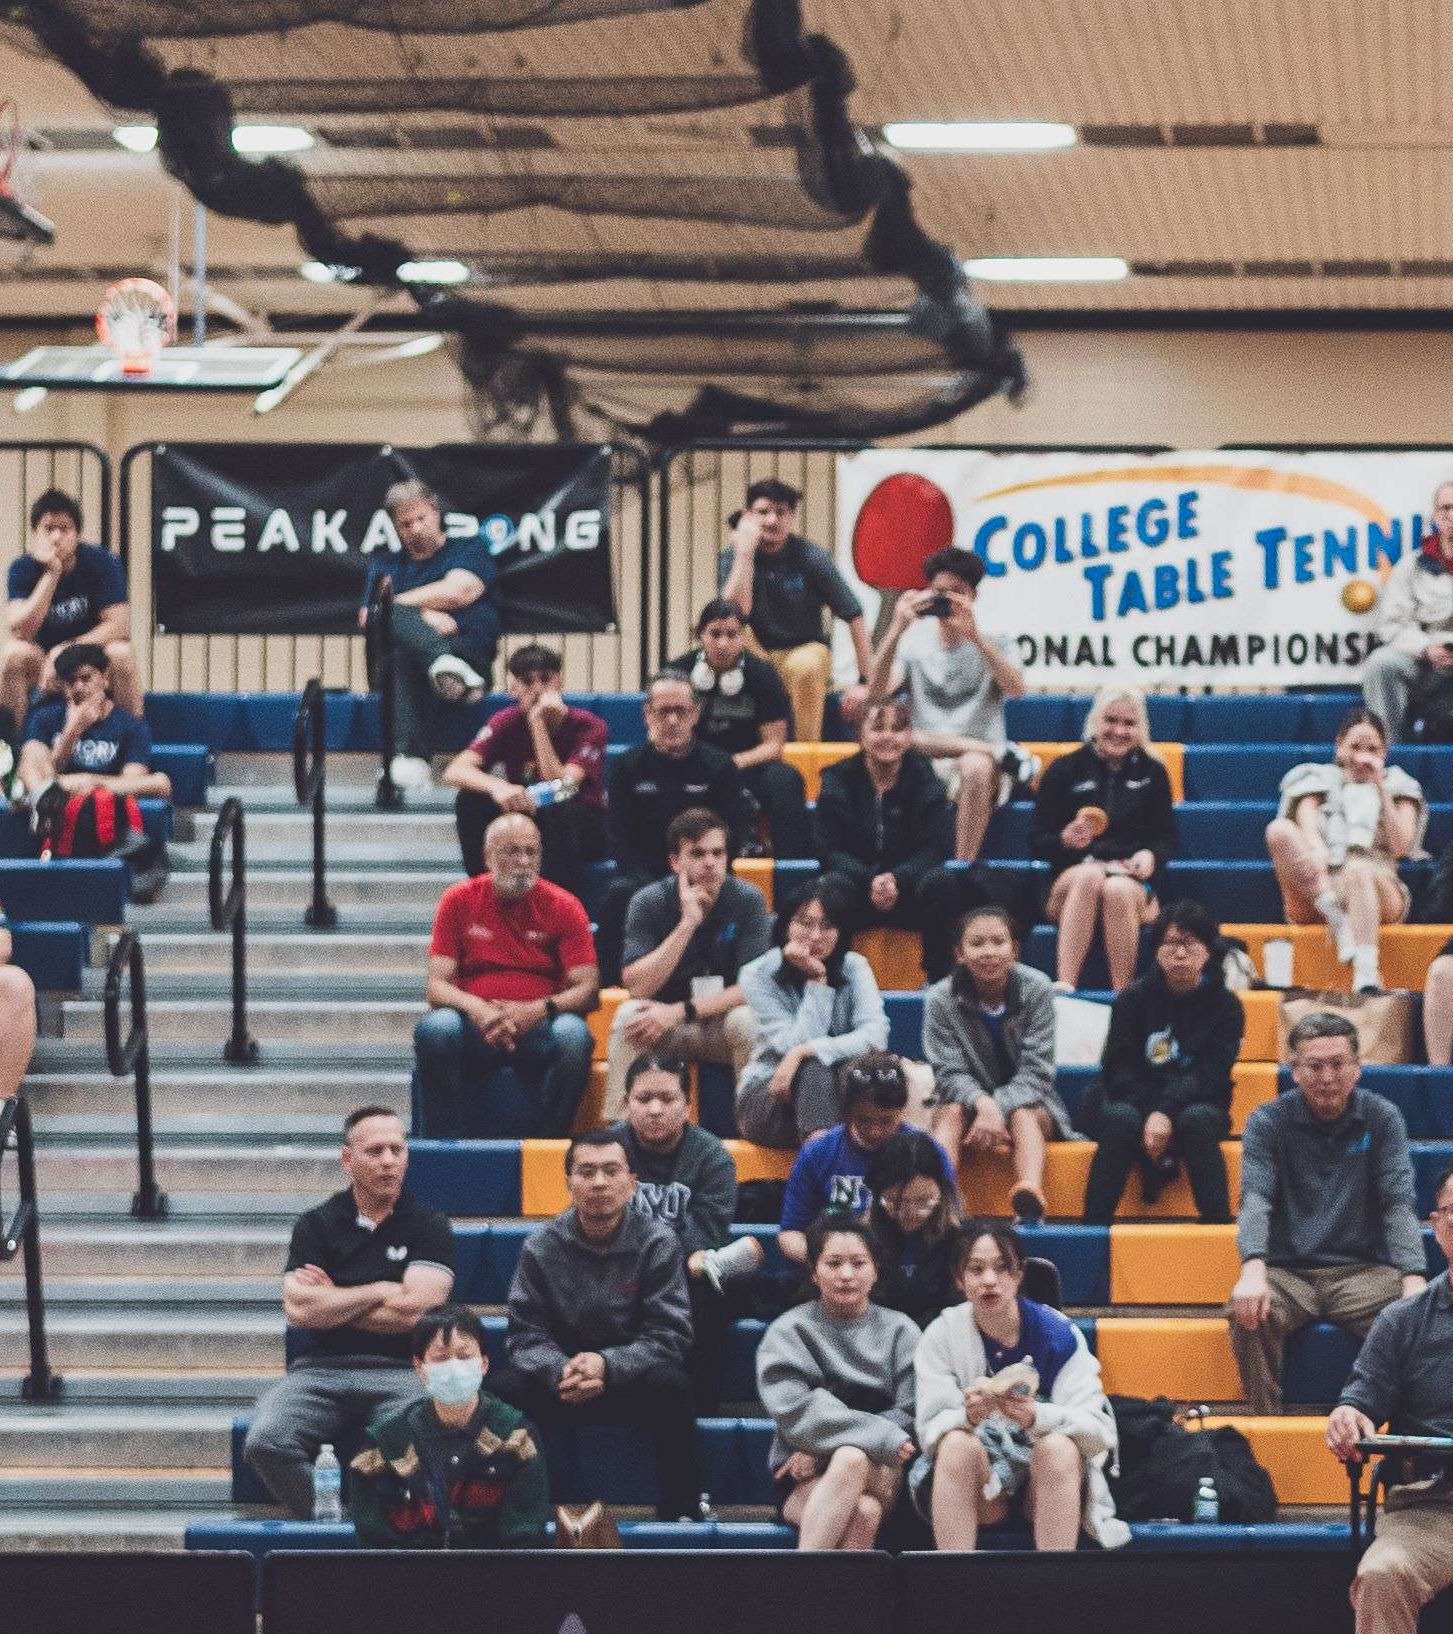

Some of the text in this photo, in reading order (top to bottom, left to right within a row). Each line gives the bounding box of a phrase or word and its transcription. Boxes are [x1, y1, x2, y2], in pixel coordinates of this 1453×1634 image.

[974, 491, 1199, 577] COLLEGE
[1082, 514, 1423, 622] TABLE TENNI
[1017, 633, 1385, 667] ONAL CHAMPIONS
